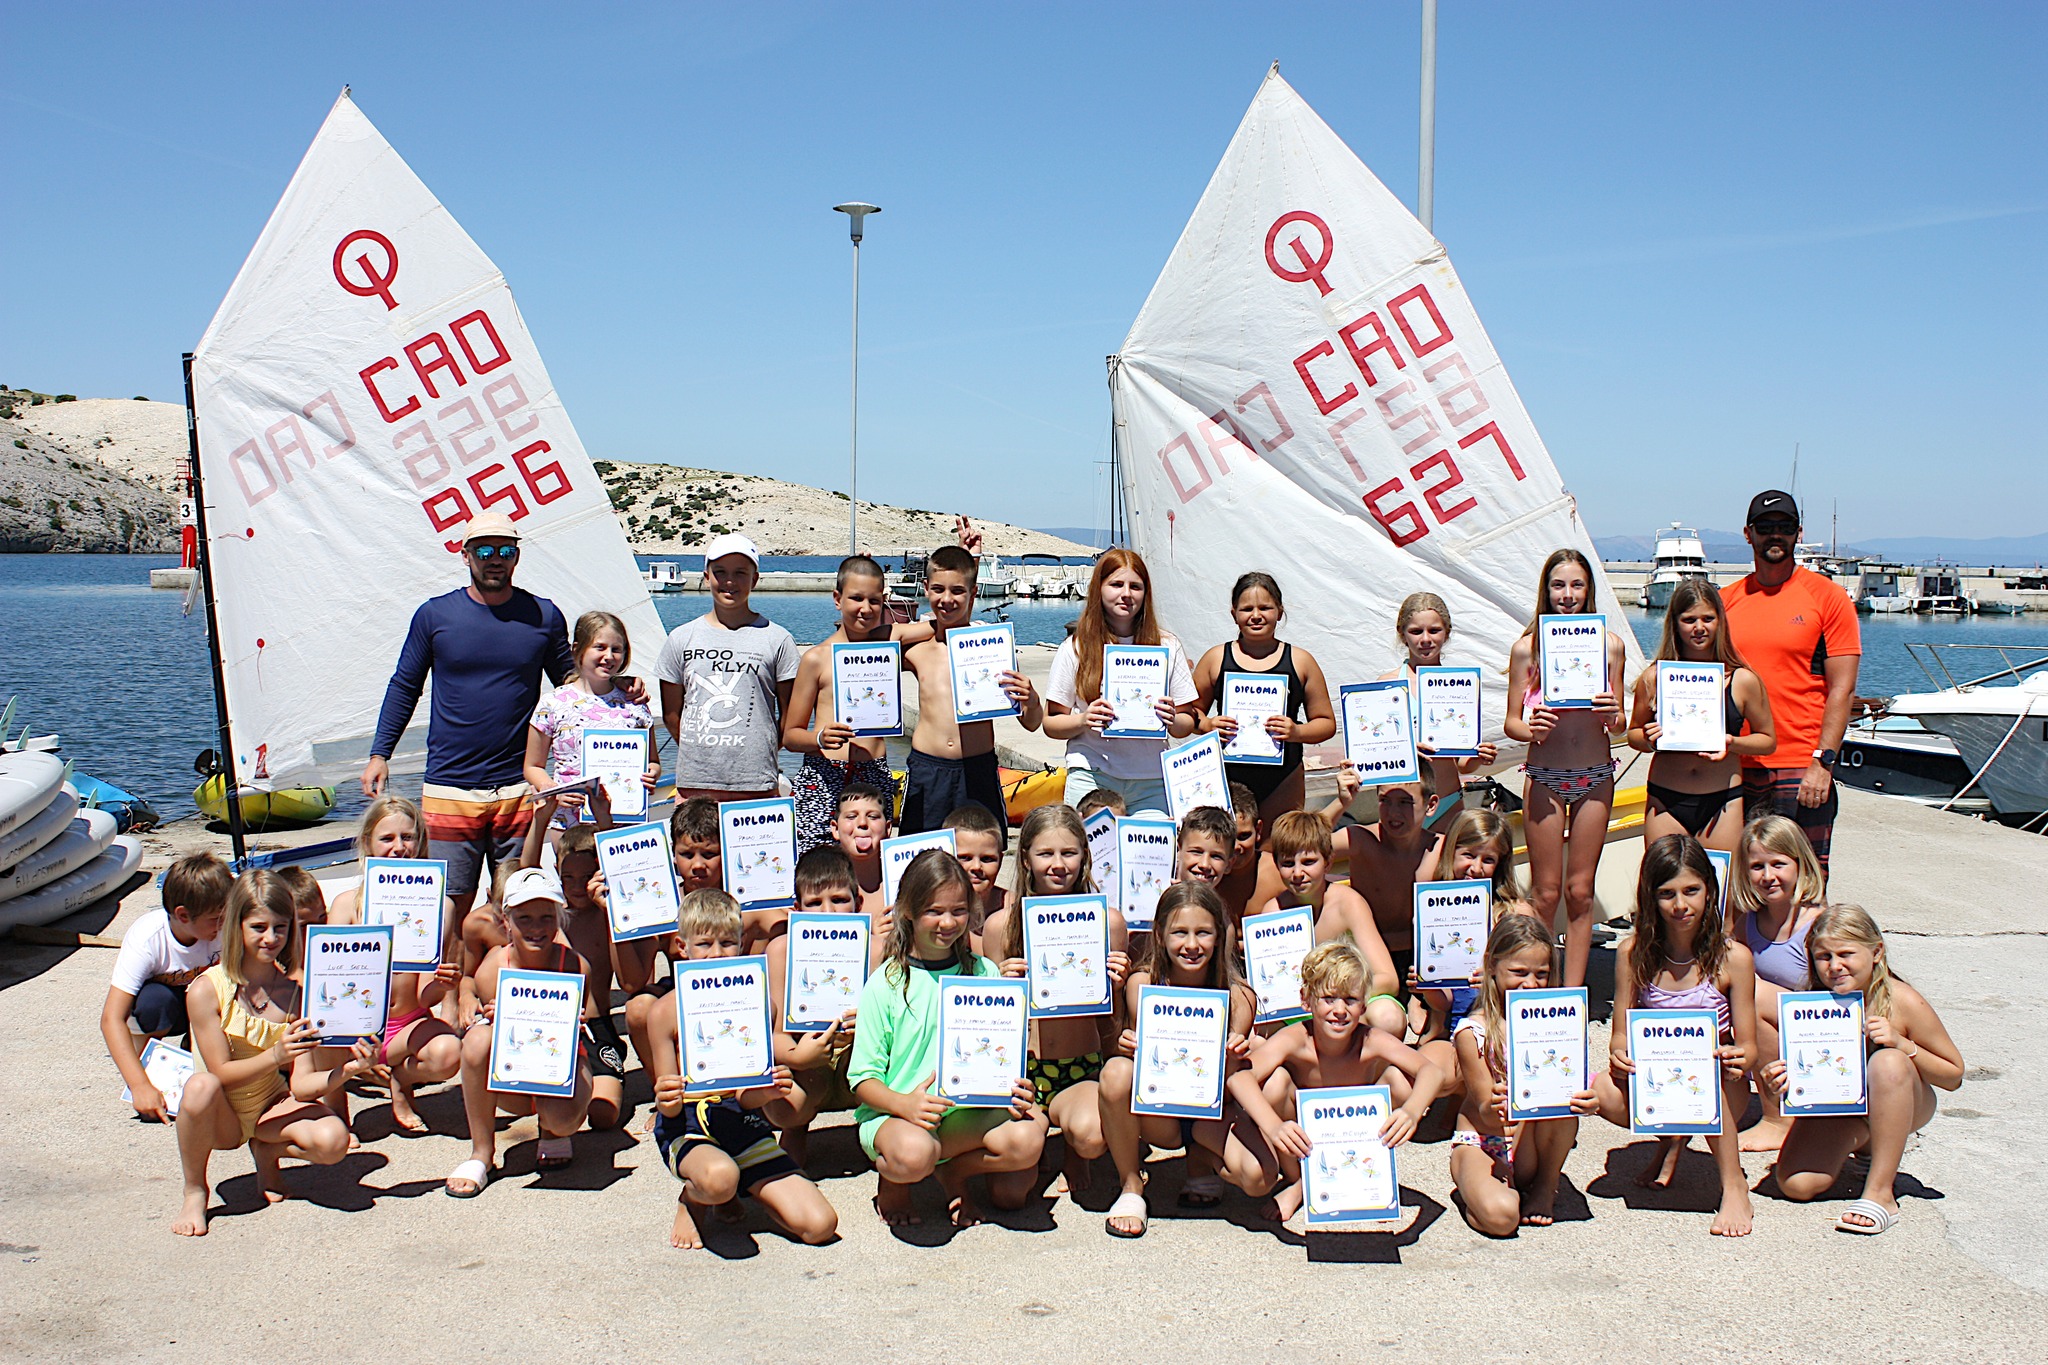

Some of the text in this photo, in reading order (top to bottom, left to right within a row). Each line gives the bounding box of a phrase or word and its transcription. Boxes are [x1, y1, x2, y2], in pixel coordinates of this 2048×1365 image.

[1362, 420, 1527, 548] 627
[421, 439, 574, 554] 956
[1552, 627, 1596, 636] DIPLOMA
[959, 637, 1004, 649] DIPLOMA
[683, 649, 733, 661] BROO
[844, 655, 890, 665] DIPLOMA
[712, 661, 760, 675] KLYN
[1116, 658, 1159, 666] DIPLOMA
[1428, 679, 1472, 687] DIPLOMA
[1669, 674, 1714, 683] DIPLOMA
[1235, 685, 1277, 694] DIPLOMA
[593, 741, 638, 749] DIPLOMA
[696, 733, 747, 747] YORK
[1173, 747, 1212, 768] DIPLOMA
[1357, 760, 1406, 772] DIPLOMA
[733, 814, 784, 827] DIPLOMA
[1128, 834, 1168, 845] DIPLOMA
[609, 838, 658, 856] DIPLOMA
[379, 874, 433, 885] DIPLOMA
[1428, 895, 1480, 907] DIPLOMA
[1038, 911, 1095, 924] DIPLOMA
[802, 929, 858, 940] DIPLOMA
[1256, 923, 1302, 939] DIPLOMA
[321, 942, 381, 953] DIPLOMA
[692, 974, 754, 990] DIPLOMA
[511, 987, 569, 1000] DIPLOMA
[954, 995, 1015, 1007] DIPLOMA
[1154, 1004, 1214, 1018] DIPLOMA
[1521, 1006, 1576, 1019] DIPLOMA
[1794, 1008, 1851, 1020] DIPLOMA
[1643, 1027, 1704, 1037] DIPLOMA
[1314, 1105, 1377, 1119] DIPLOMA
